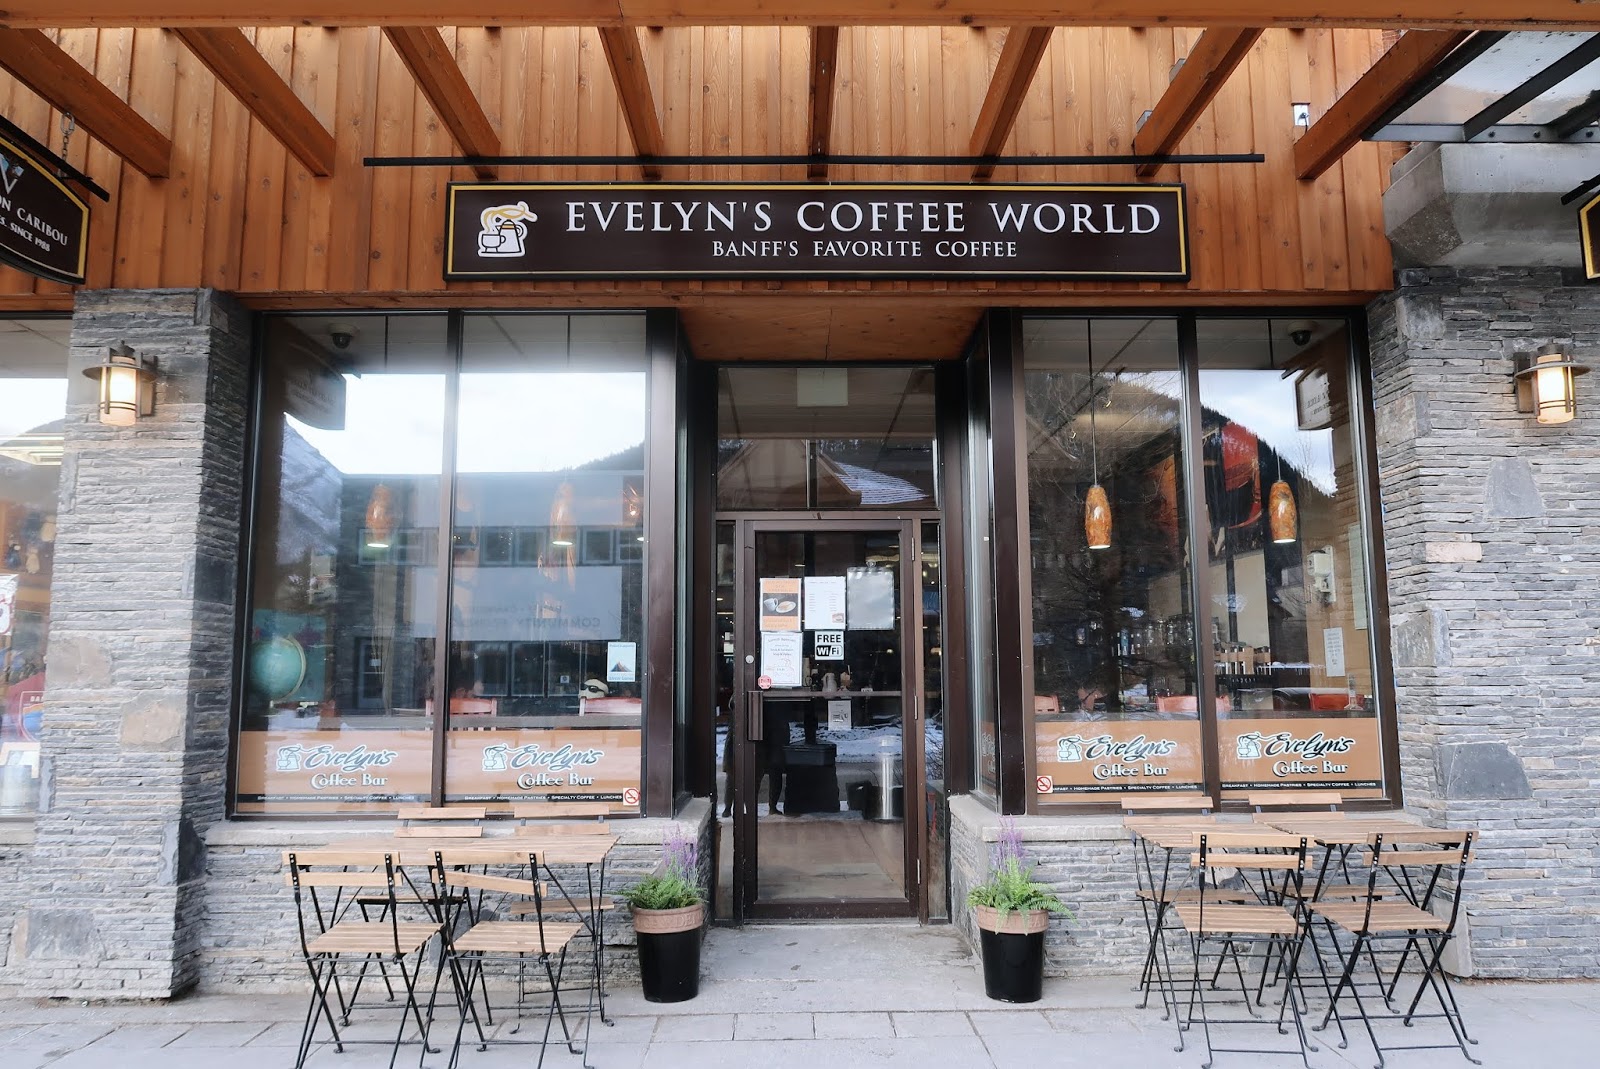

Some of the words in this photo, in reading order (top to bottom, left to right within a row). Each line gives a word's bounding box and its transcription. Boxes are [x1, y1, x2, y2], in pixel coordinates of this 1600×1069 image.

[0, 195, 11, 211] N
[17, 208, 68, 246] CARIBOU
[566, 201, 772, 232] EVELYN'S
[797, 200, 966, 232] COFFEE
[988, 202, 1161, 234] WORLD
[10, 222, 33, 242] SINCE
[34, 237, 51, 252] 1988
[712, 240, 799, 257] BANFF'S
[813, 241, 922, 257] FAVORITE
[935, 241, 1018, 258] COFFEE
[817, 634, 841, 643] FREE
[1093, 764, 1139, 780] Coffee
[1143, 763, 1169, 776] Bar
[1272, 761, 1318, 777] Coffee
[1322, 761, 1348, 774] Bar
[311, 773, 357, 790] Coffee
[361, 773, 388, 787] Bar
[517, 773, 564, 790] Coffee
[568, 773, 595, 787] Bar
